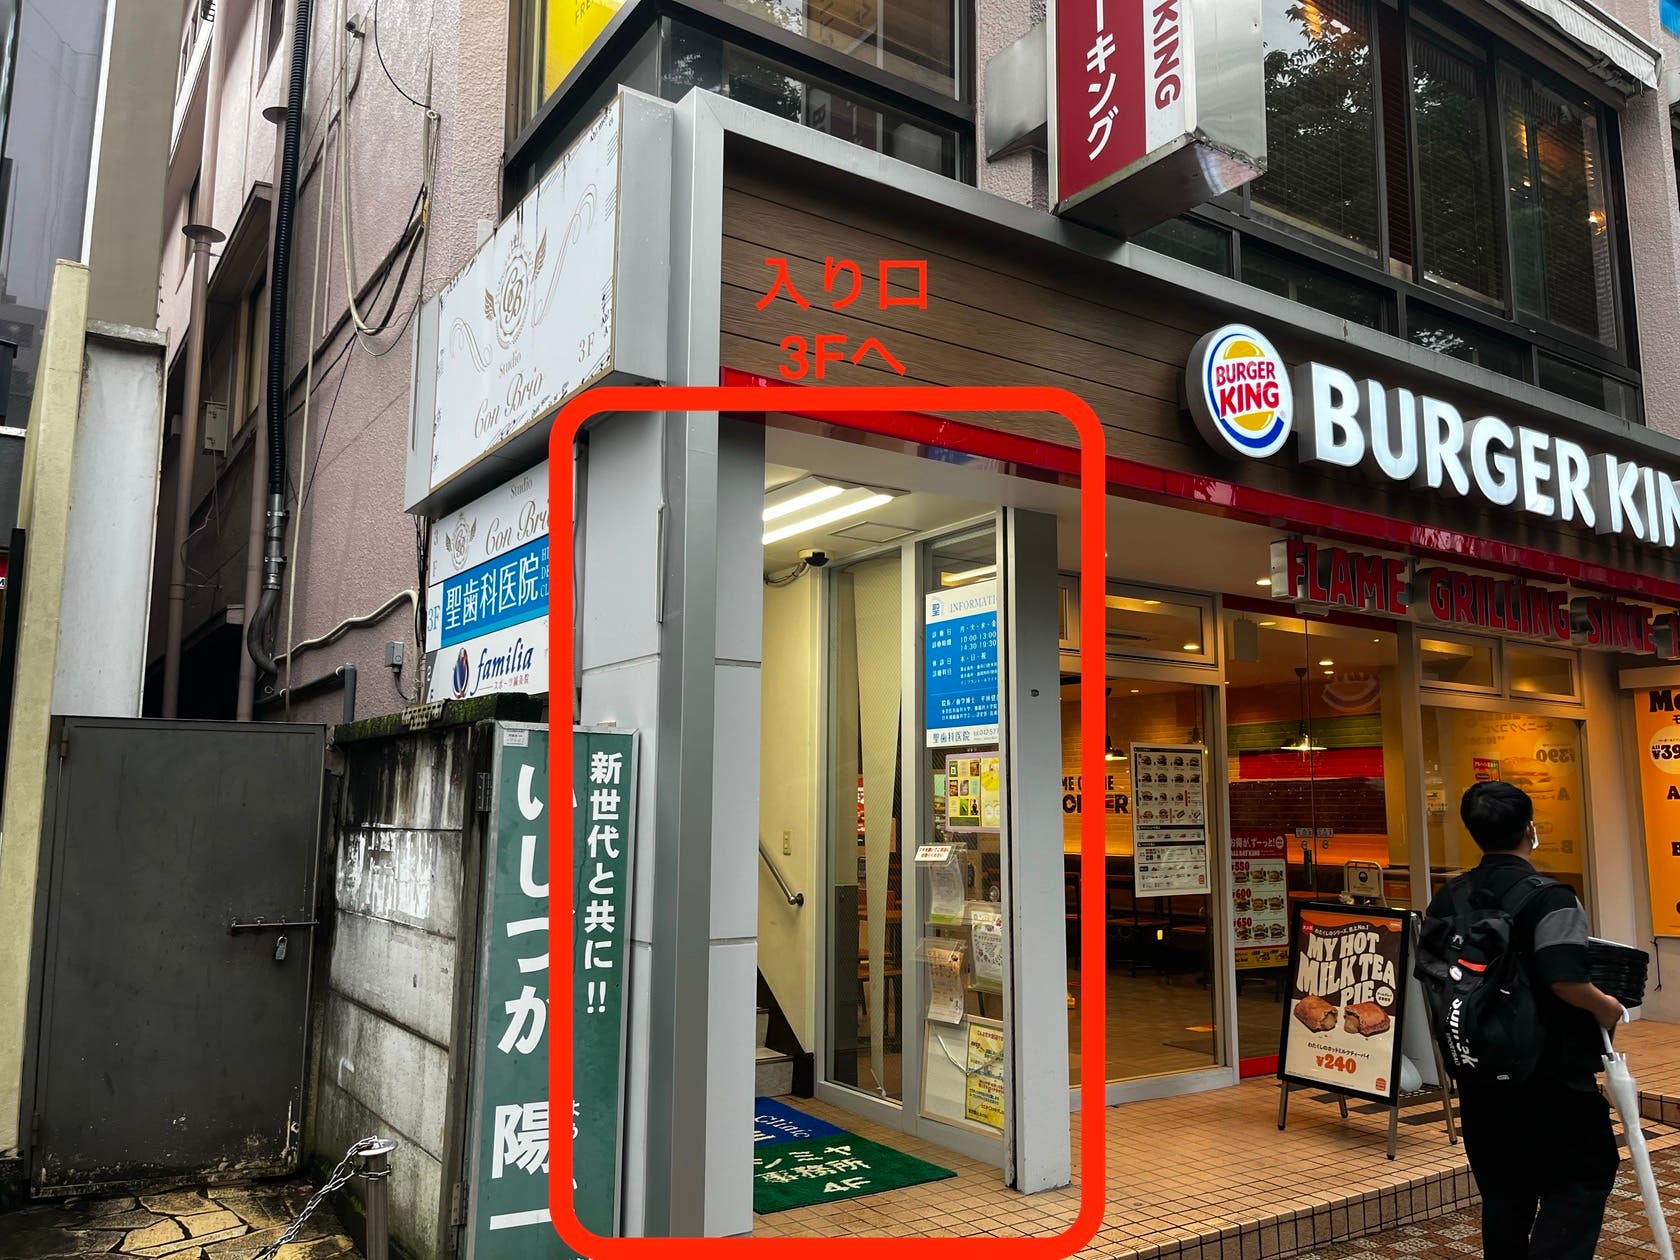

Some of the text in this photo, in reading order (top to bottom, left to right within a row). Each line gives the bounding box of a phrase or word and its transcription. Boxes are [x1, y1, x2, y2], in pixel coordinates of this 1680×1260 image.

[1153, 0, 1181, 110] KING
[578, 331, 595, 362] 3F
[1216, 360, 1276, 387] BURGER
[475, 399, 501, 440] Con
[1220, 381, 1280, 419] KING
[1311, 362, 1595, 529] BURGER
[486, 498, 549, 555] Con Bri
[446, 552, 539, 631] 聖歯科医院
[1286, 538, 1408, 615] FLAME
[1428, 567, 1570, 641] GRILLING
[1586, 598, 1655, 651] SINCE
[428, 604, 441, 632] 3F
[470, 637, 534, 697] familia
[1307, 931, 1379, 961] MY HOT
[1296, 951, 1396, 997] MILK TEA
[1340, 980, 1374, 1009] PIE
[1316, 1053, 1357, 1074] ¥240
[823, 1176, 871, 1193] 4F
